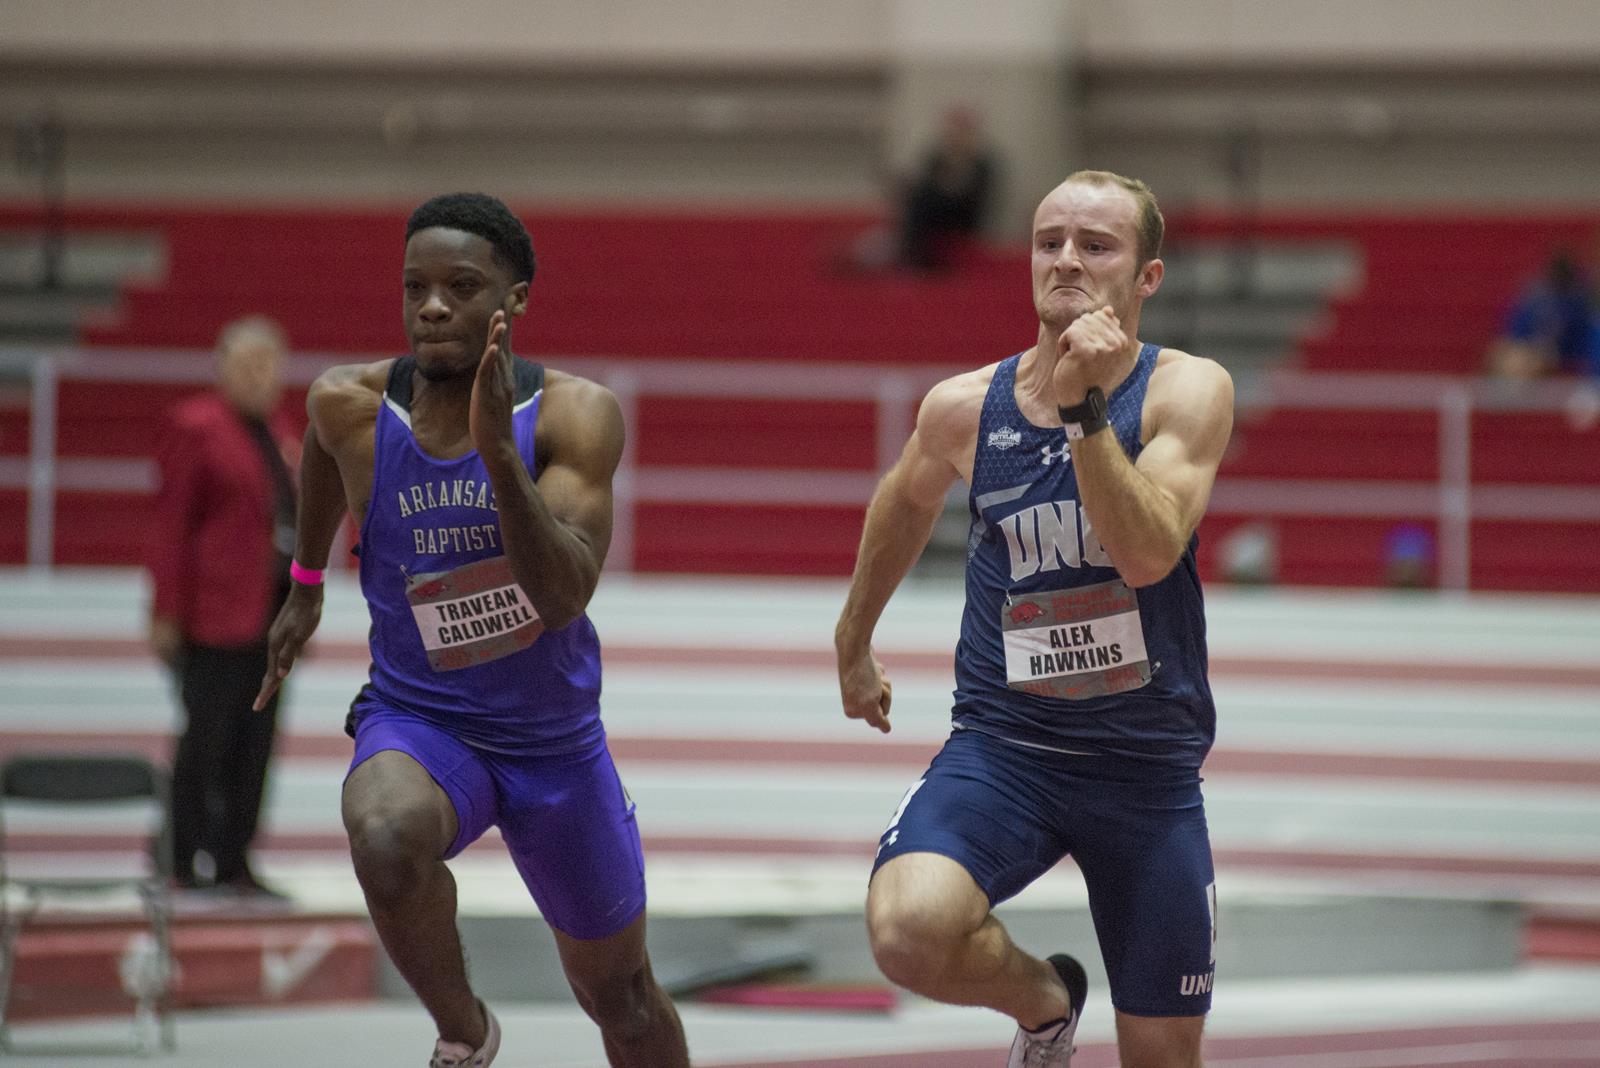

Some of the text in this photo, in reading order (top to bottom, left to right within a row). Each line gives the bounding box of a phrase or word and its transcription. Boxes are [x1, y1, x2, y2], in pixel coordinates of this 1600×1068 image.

[413, 525, 497, 554] BAPTIST
[436, 588, 519, 622] TRAVEAN
[438, 606, 532, 644] CALDWELL
[1050, 624, 1095, 649] ALEX
[1030, 643, 1123, 676] HAWKINS
